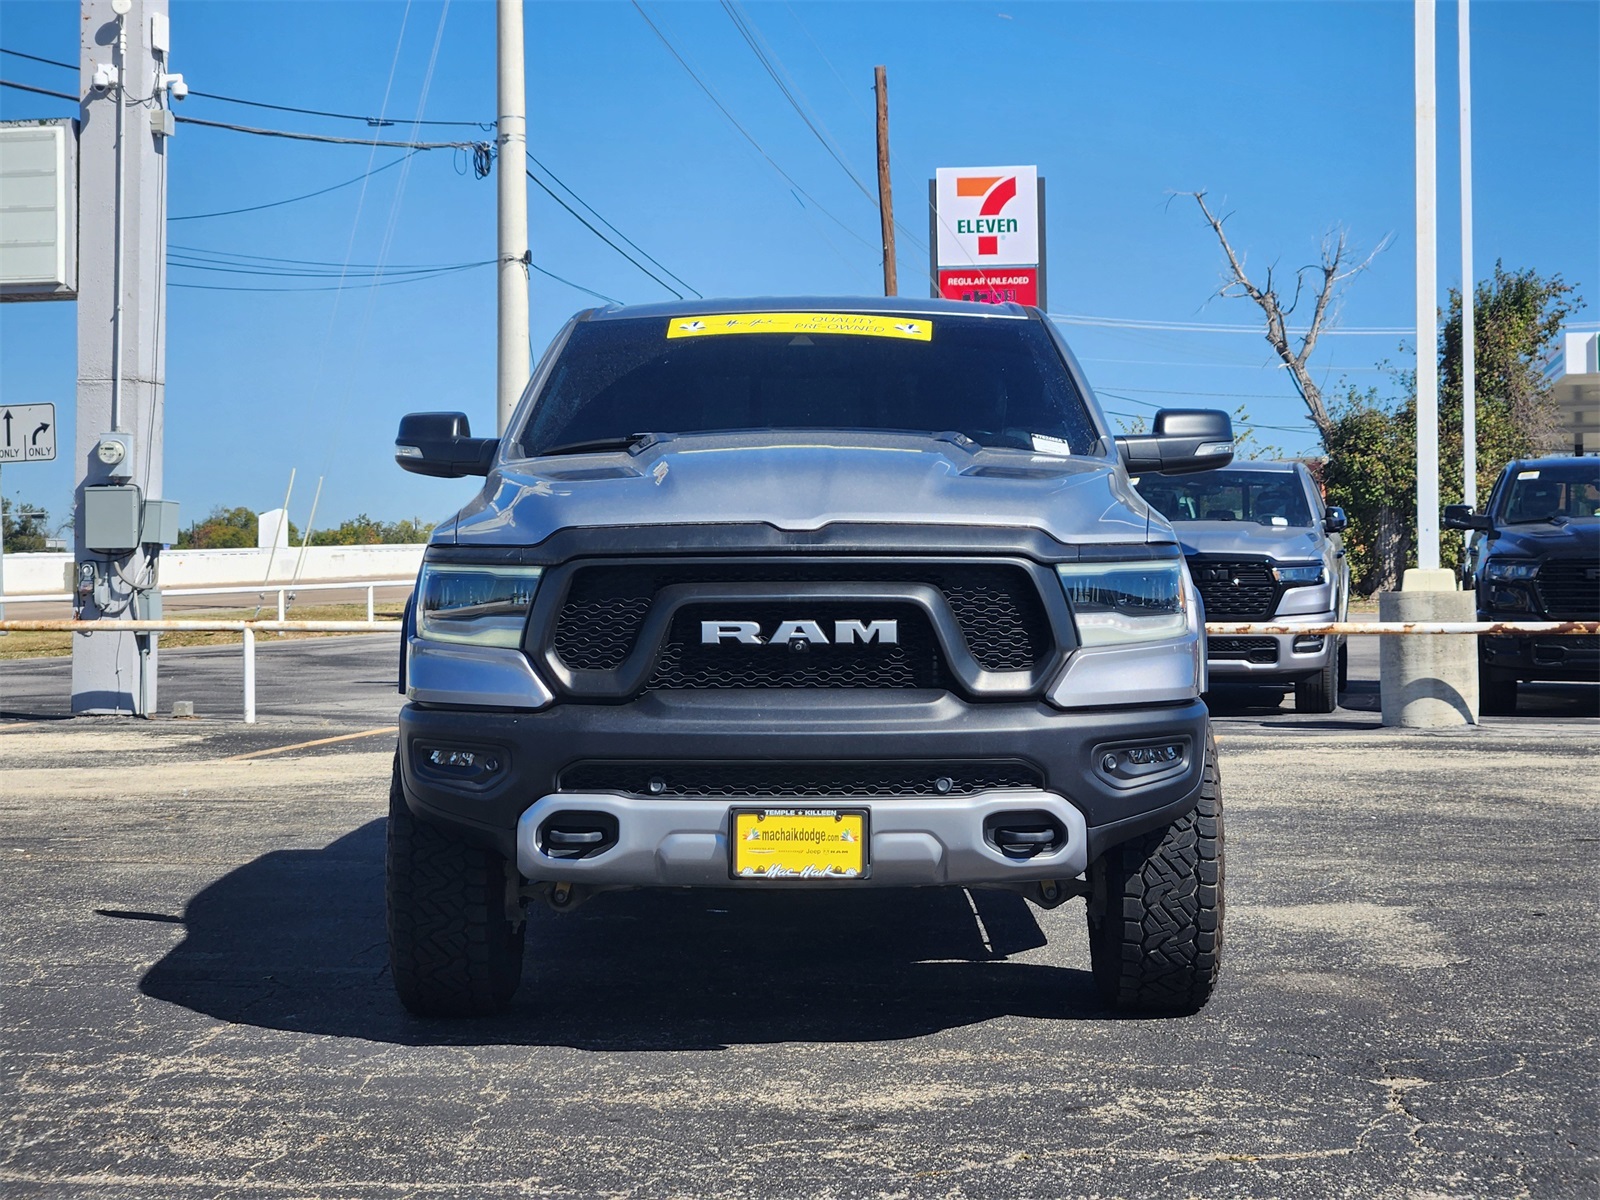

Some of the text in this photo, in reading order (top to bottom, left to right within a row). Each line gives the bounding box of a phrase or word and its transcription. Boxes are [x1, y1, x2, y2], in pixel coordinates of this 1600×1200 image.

[957, 176, 1016, 254] 7
[947, 276, 1029, 286] REGULAR UNLEADED
[795, 323, 884, 332] PRE-OWNED
[0, 448, 19, 458] ONLY
[29, 447, 51, 456] ONLY
[701, 619, 898, 645] RAM
[762, 828, 839, 844] machaikdodge.com
[765, 863, 799, 878] Mac
